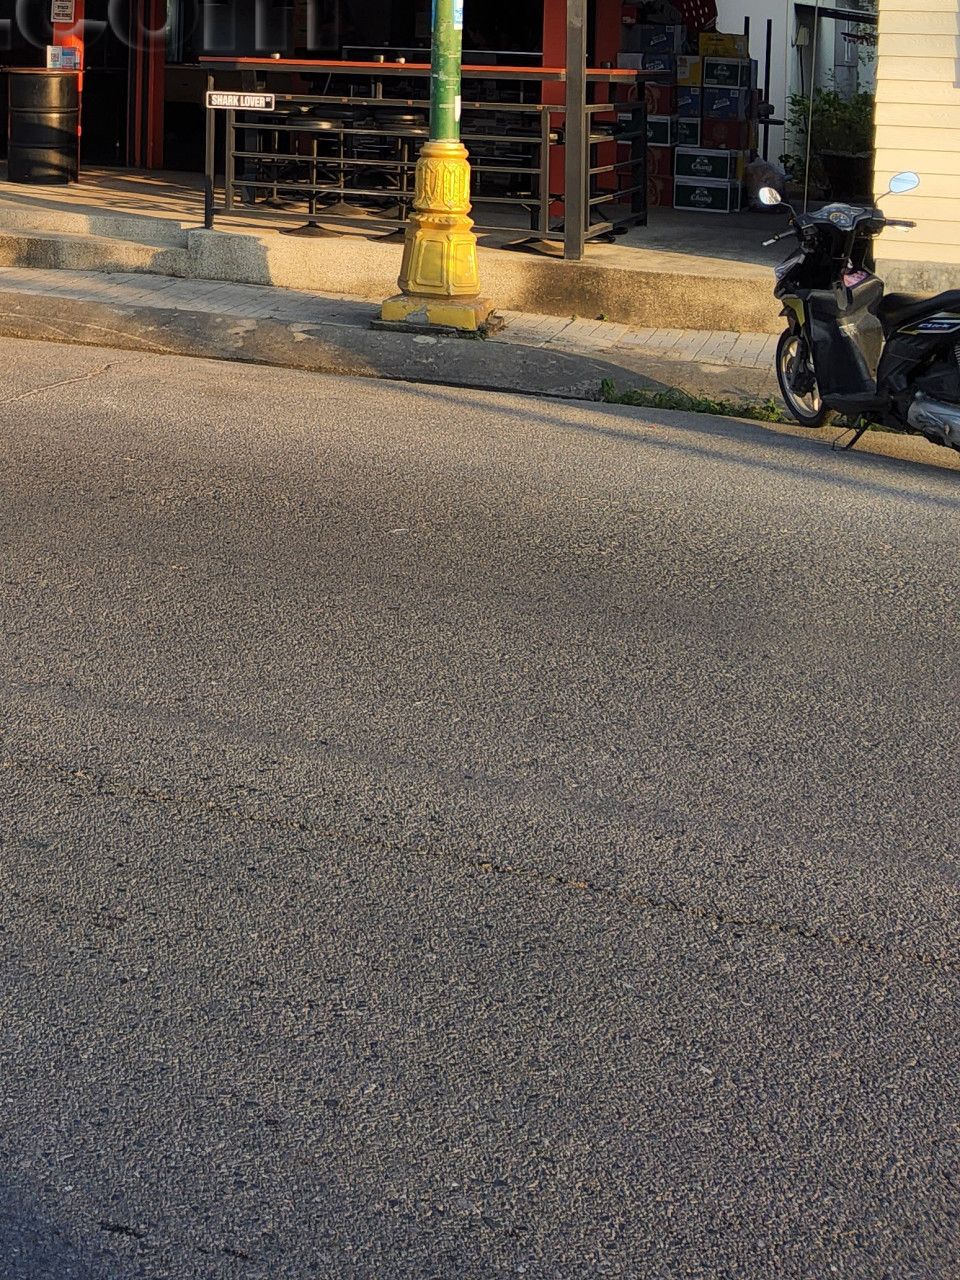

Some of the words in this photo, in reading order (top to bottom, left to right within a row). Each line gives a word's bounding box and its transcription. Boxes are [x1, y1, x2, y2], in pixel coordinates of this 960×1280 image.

[211, 94, 239, 106] SHARK
[240, 95, 266, 108] LOVER
[691, 160, 713, 173] Chang
[690, 192, 713, 204] Chang
